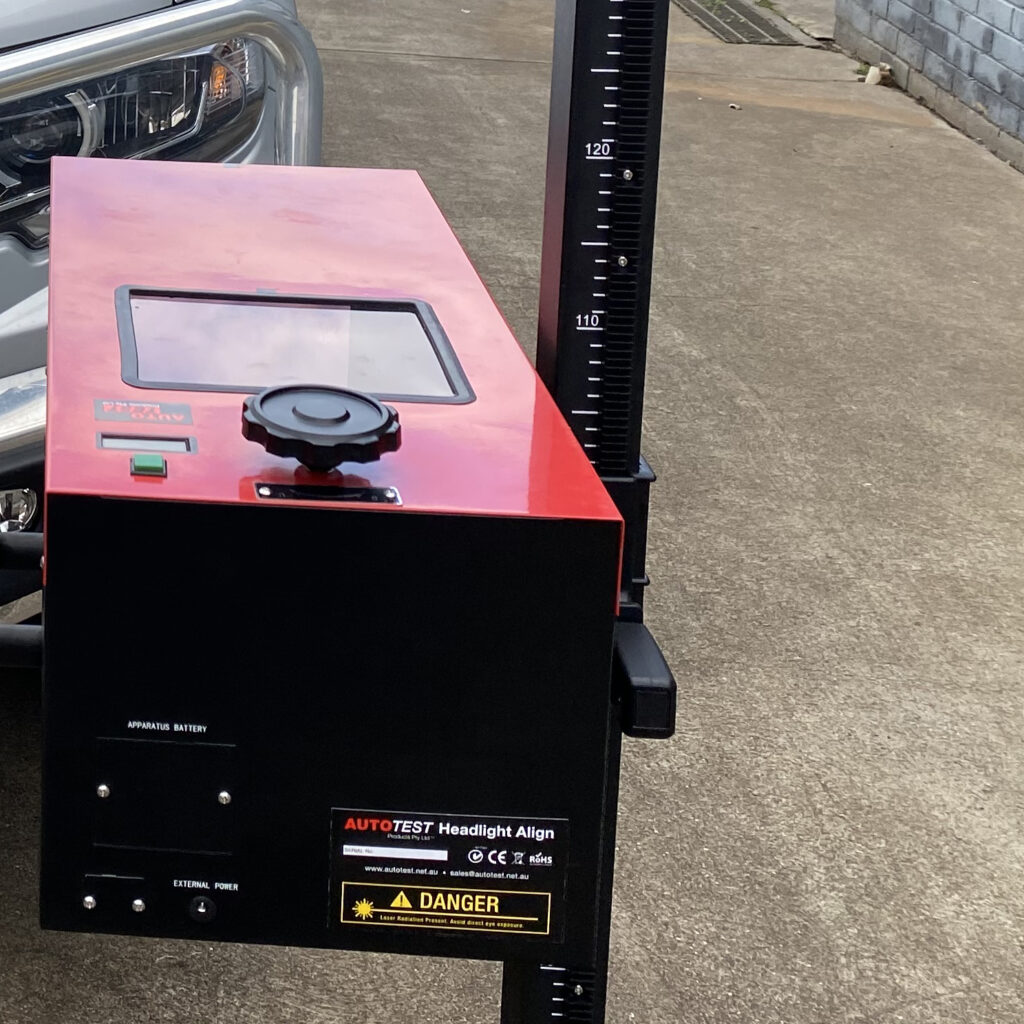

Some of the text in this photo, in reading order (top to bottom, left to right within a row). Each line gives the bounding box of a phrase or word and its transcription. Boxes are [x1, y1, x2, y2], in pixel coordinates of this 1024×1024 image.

[585, 143, 611, 156] 120
[576, 314, 599, 327] 110
[127, 720, 208, 733] APPARATUS BATTERY
[344, 817, 555, 842] AUTOTEST Headlight Align
[364, 865, 530, 881] www.autotest.net.au sales@autotest.net.au
[173, 879, 239, 892] EXTERNAL POWER
[420, 891, 500, 913] DANGER
